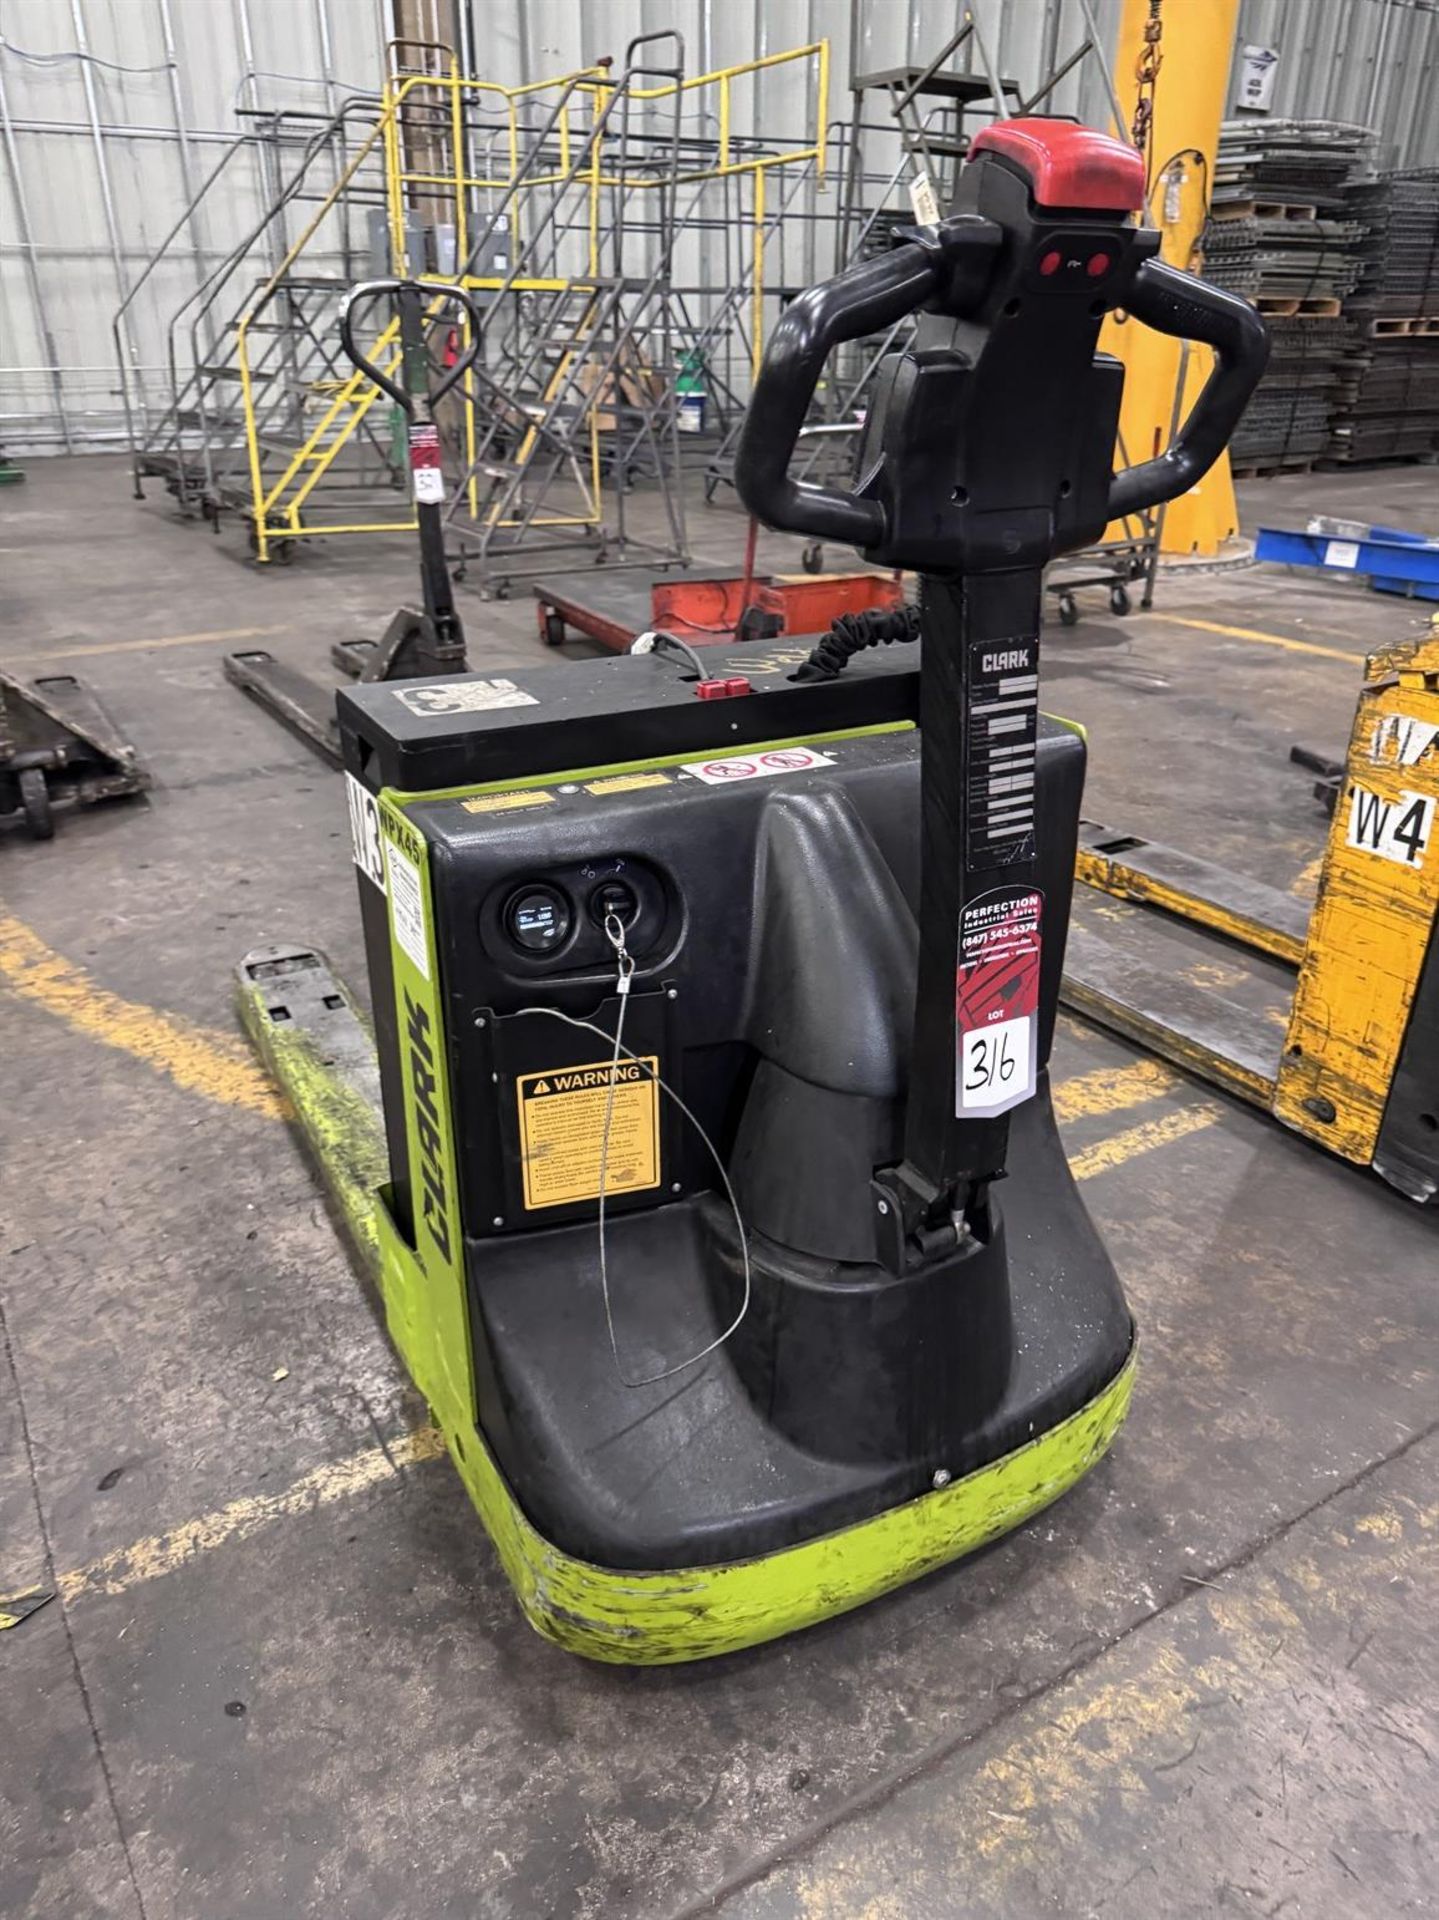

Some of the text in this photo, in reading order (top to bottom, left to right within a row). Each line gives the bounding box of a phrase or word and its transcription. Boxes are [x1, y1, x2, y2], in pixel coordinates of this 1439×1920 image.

[982, 649, 1029, 673] CLARK
[1355, 790, 1426, 862] W4
[964, 907, 1038, 929] Industrial Sales
[965, 895, 1038, 921] PERFECTION
[962, 931, 988, 949] (847)
[990, 922, 1038, 941] 545-6374
[988, 1009, 1004, 1021] LOT
[965, 1031, 1016, 1091] 316
[553, 1065, 640, 1091] WARNING
[402, 986, 452, 1266] CLARK
